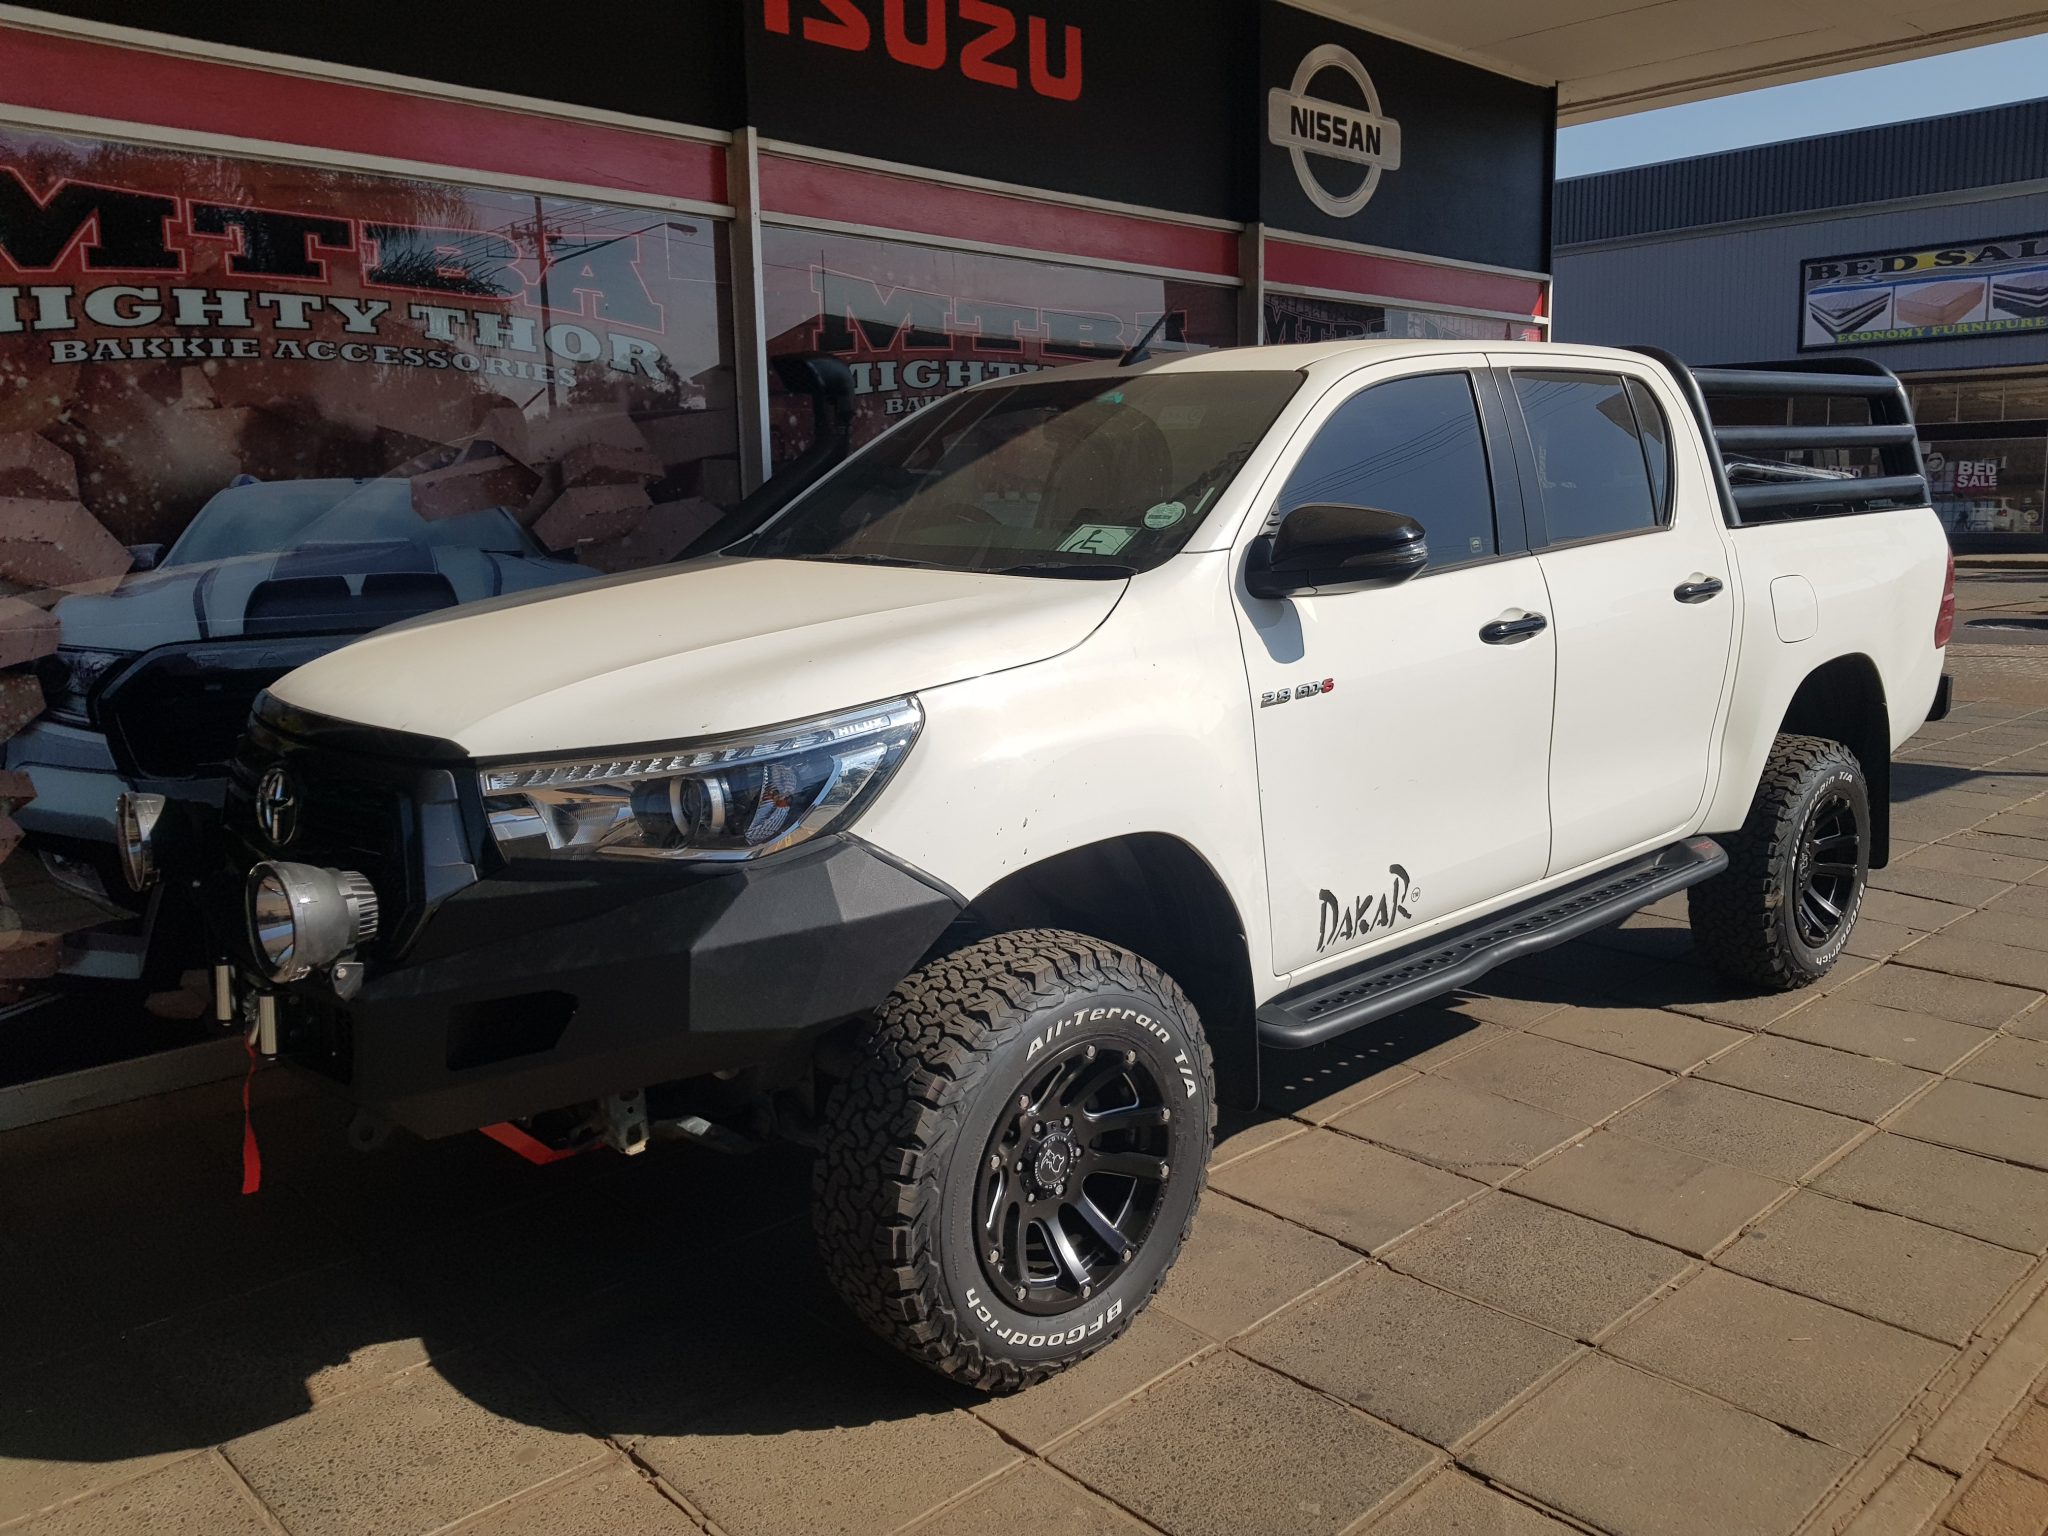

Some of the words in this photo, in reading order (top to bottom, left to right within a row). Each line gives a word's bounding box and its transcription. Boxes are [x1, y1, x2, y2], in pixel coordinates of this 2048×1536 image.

[1290, 105, 1381, 156] NISSAN
[0, 165, 666, 334] MTBA
[1808, 255, 1917, 281] BED
[410, 303, 666, 382] THOR
[1837, 327, 1927, 343] ECONOMY
[1931, 317, 2046, 336] FURNITURE
[50, 335, 260, 363] BAKKIE
[273, 339, 578, 388] ACCESSORIES
[1956, 475, 1998, 488] SALE
[1958, 461, 1997, 476] BED
[1316, 863, 1412, 953] DAKAR
[1025, 1006, 1171, 1061] All-Terrain
[1174, 1048, 1197, 1098] T/A
[964, 1286, 1122, 1347] BFGoodrich
